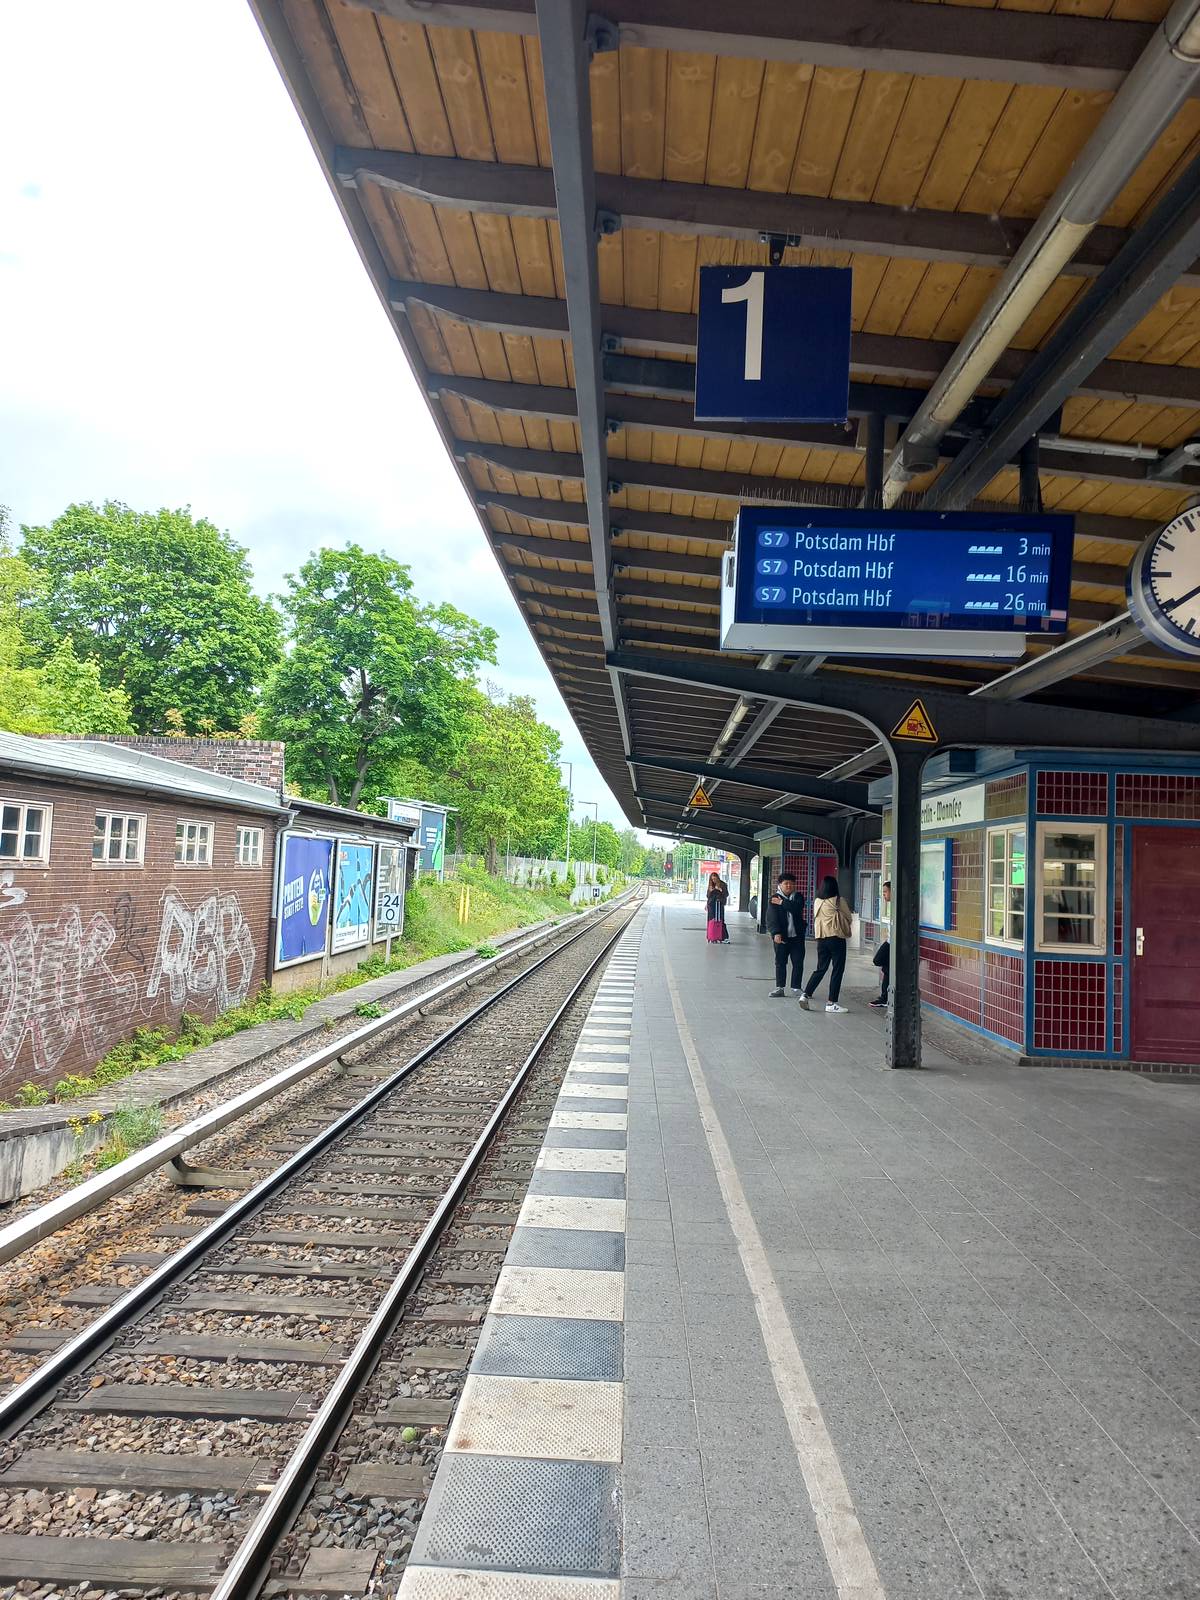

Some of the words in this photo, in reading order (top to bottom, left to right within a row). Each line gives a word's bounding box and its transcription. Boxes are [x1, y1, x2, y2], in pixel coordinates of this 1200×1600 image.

[721, 271, 765, 381] 1
[764, 532, 784, 546] S7
[795, 532, 862, 551] Potsdam
[867, 533, 896, 552] Hbf
[1018, 537, 1028, 556] 3
[1031, 544, 1051, 556] min
[762, 560, 782, 573] S7
[793, 560, 860, 578] Potsdam
[865, 561, 894, 579] Hbf
[1006, 565, 1027, 583] 16
[1030, 572, 1049, 583] min
[761, 588, 781, 601] S7
[792, 587, 859, 606] Potsdam
[863, 589, 893, 607] Hbf
[1003, 593, 1025, 611] 26
[1028, 600, 1047, 611] min
[383, 894, 400, 908] 24
